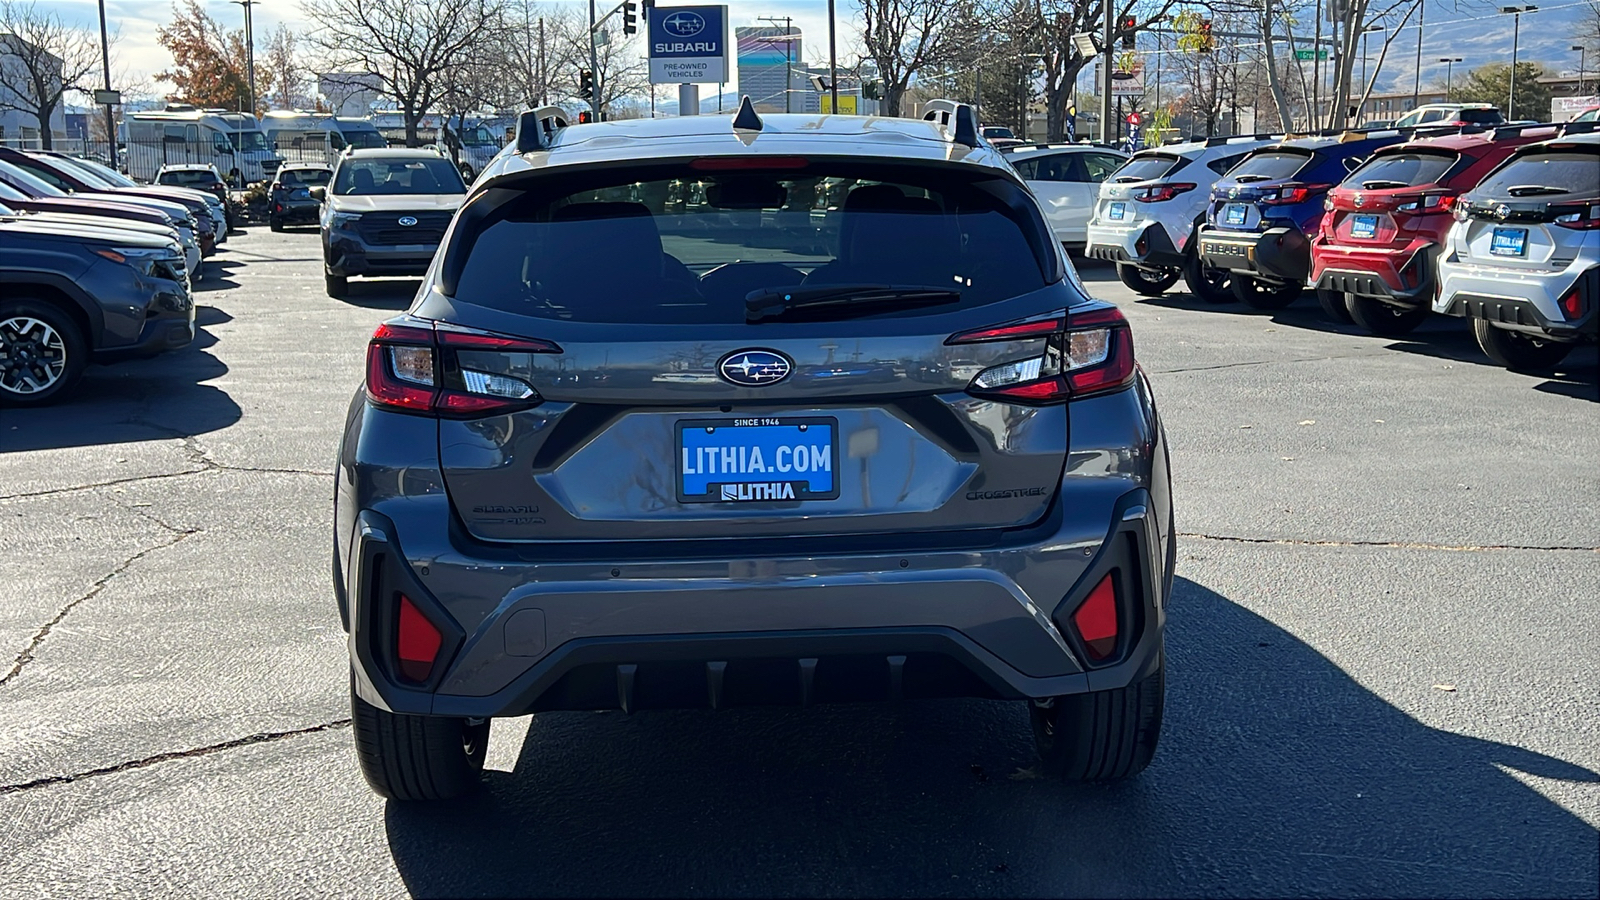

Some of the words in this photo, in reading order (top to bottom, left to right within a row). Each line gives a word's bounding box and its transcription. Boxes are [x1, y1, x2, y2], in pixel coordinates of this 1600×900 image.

[655, 42, 716, 53] SUBARU
[663, 62, 708, 70] PRE-OWNED
[734, 419, 759, 427] SINCE
[761, 418, 780, 426] 1946
[682, 444, 831, 475] LITHIA.COM
[738, 482, 796, 500] LITHIA
[965, 486, 1048, 501] CROSSTREK
[472, 505, 540, 514] SUBARU
